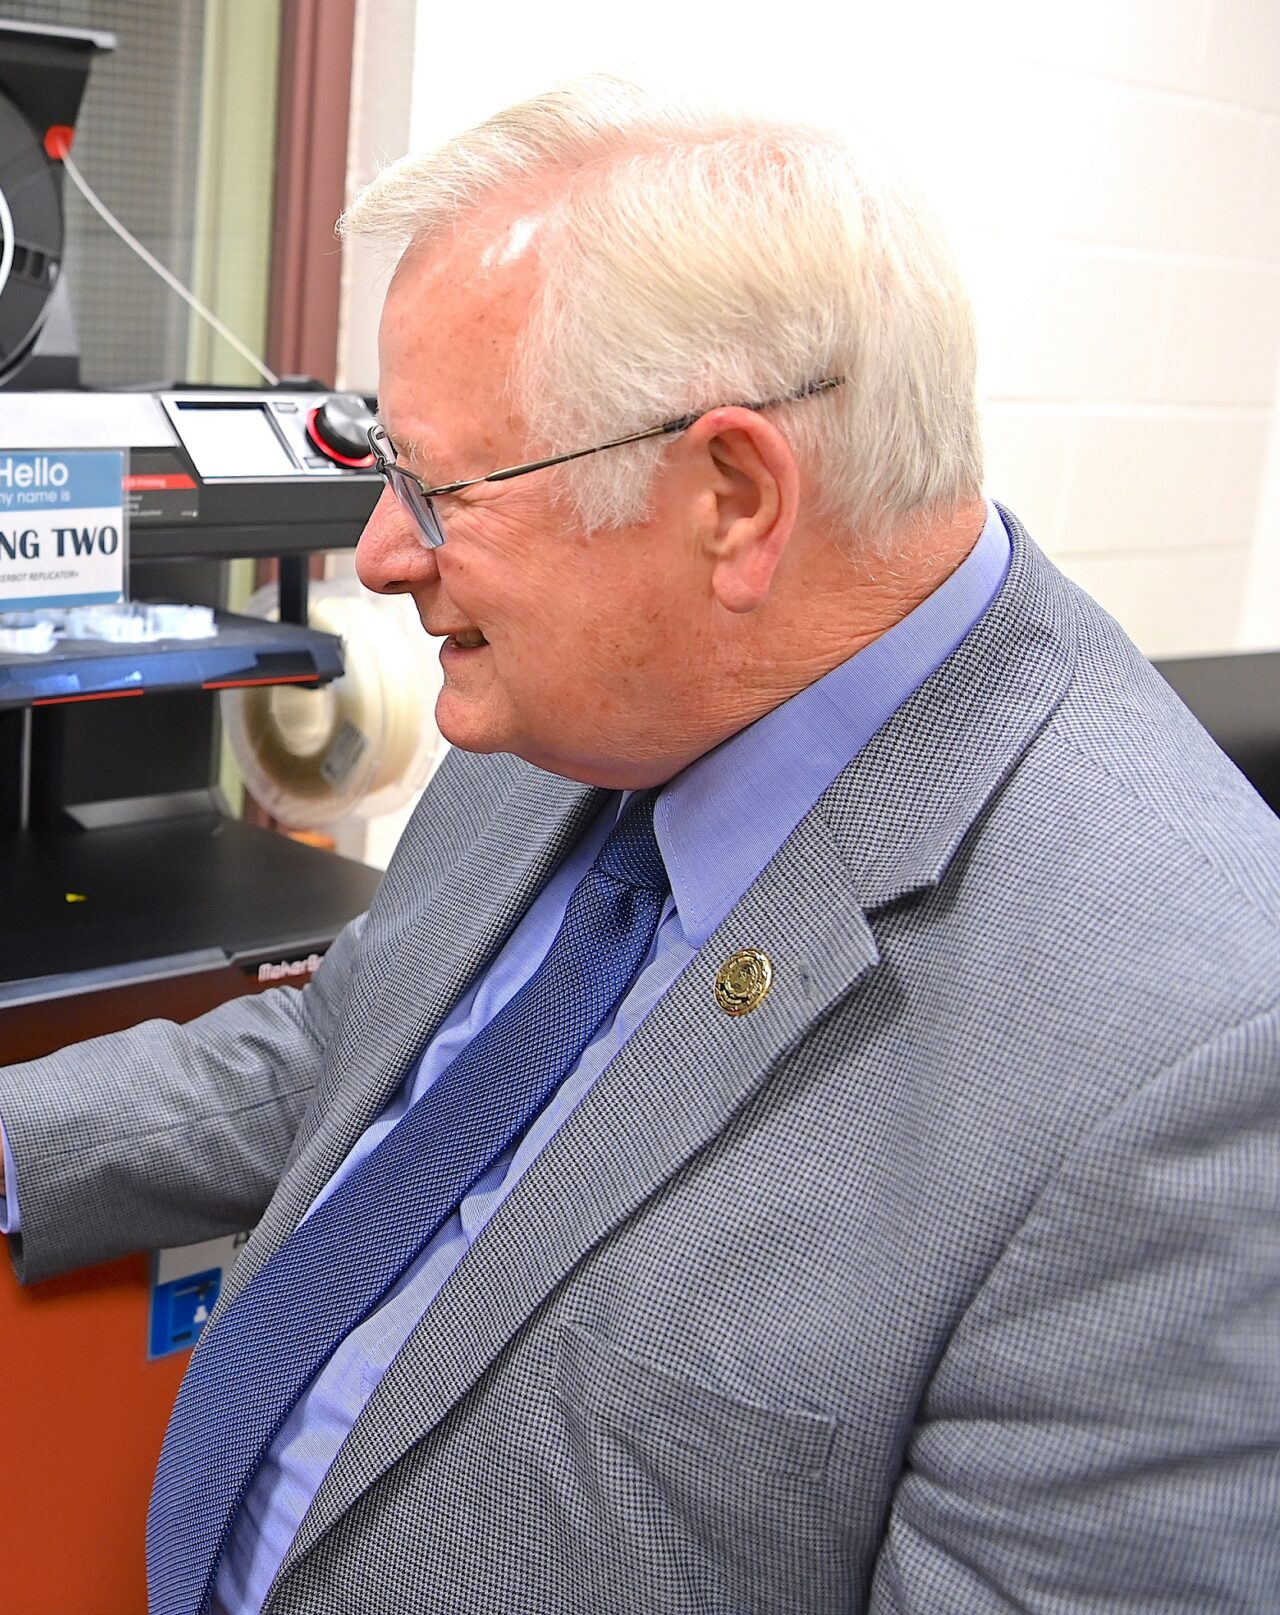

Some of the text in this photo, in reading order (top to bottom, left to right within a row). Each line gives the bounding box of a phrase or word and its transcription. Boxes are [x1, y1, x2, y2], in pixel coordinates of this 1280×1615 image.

[17, 490, 56, 503] name
[60, 489, 71, 501] is
[51, 526, 118, 558] TWO
[259, 953, 324, 981] MakerB
